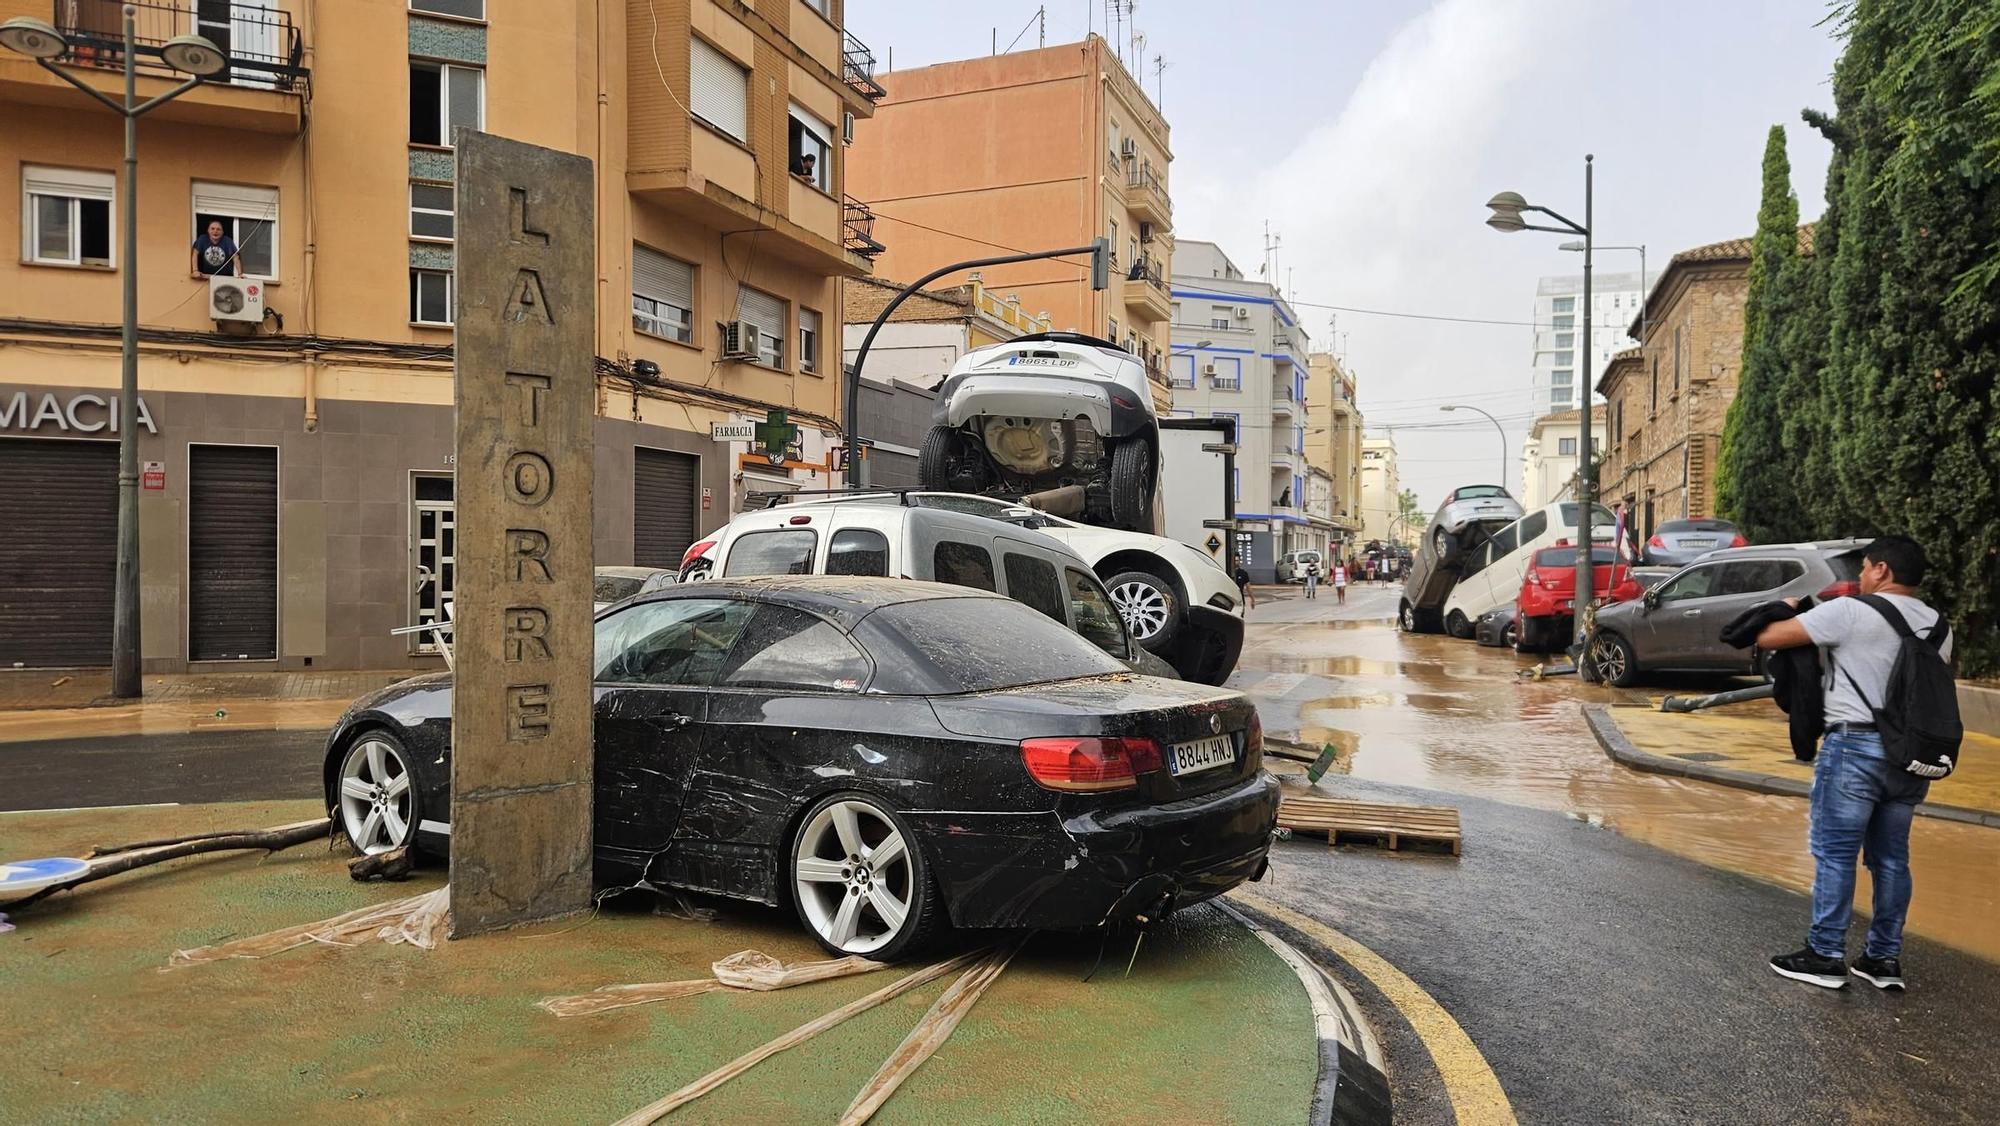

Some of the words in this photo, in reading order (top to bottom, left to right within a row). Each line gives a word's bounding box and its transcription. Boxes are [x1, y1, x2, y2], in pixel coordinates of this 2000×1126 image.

[504, 186, 555, 325] LA
[1052, 359, 1075, 367] LDP
[715, 426, 753, 437] FARMACIA
[503, 371, 555, 743] TORRE
[1177, 742, 1210, 769] 8844
[1210, 737, 1232, 762] HNJ
